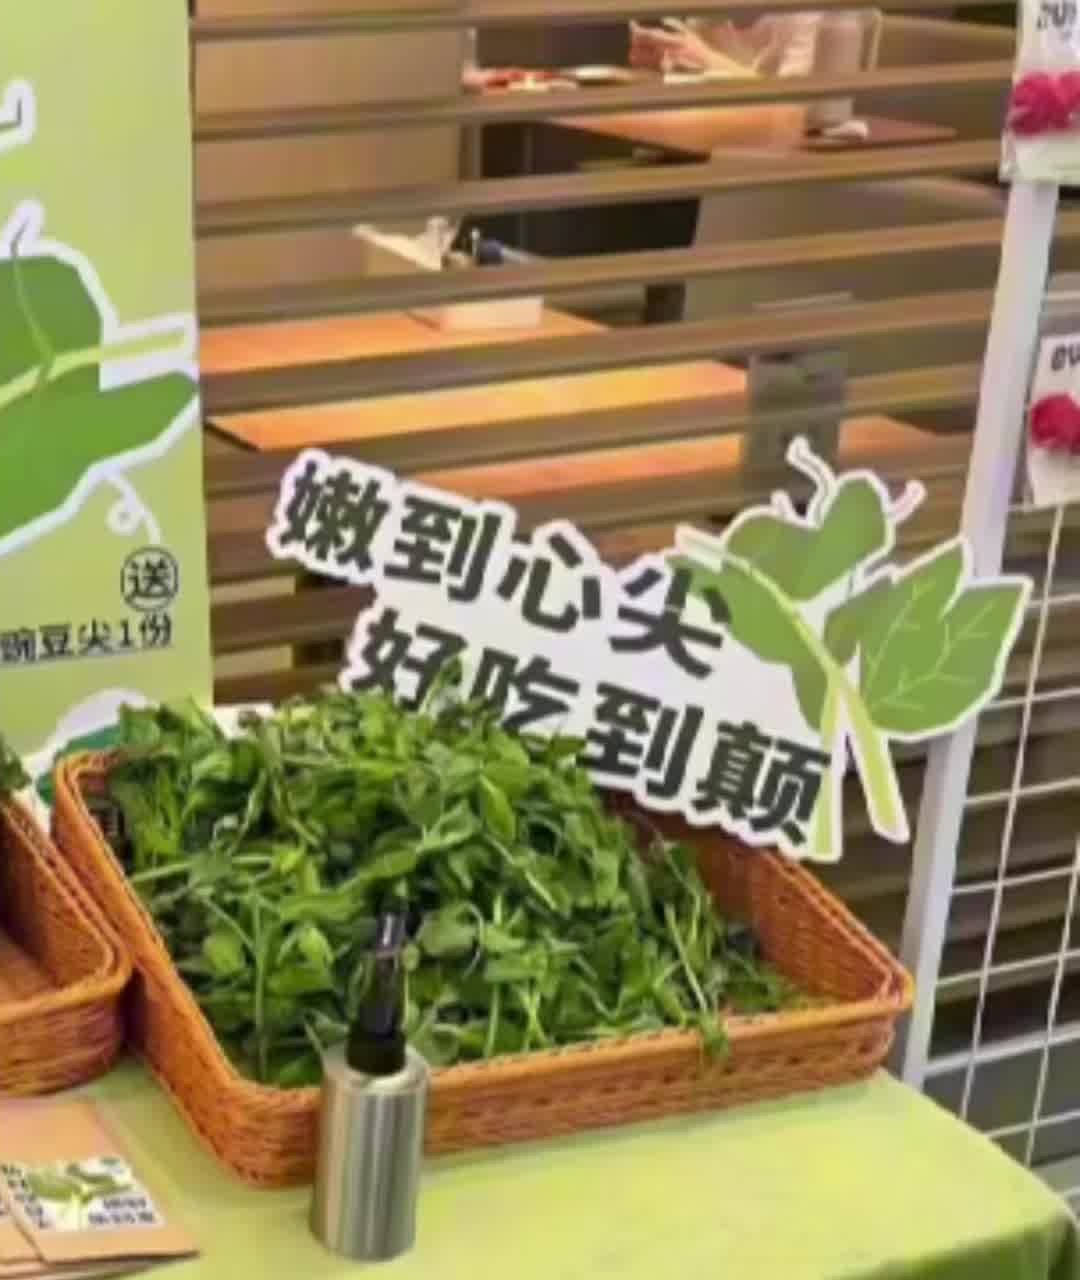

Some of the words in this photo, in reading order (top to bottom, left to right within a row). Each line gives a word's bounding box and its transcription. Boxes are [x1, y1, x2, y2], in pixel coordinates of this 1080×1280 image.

[124, 553, 174, 606] 送
[283, 462, 732, 679] 嫩到心尖
[351, 608, 831, 844] 好吃到颠
